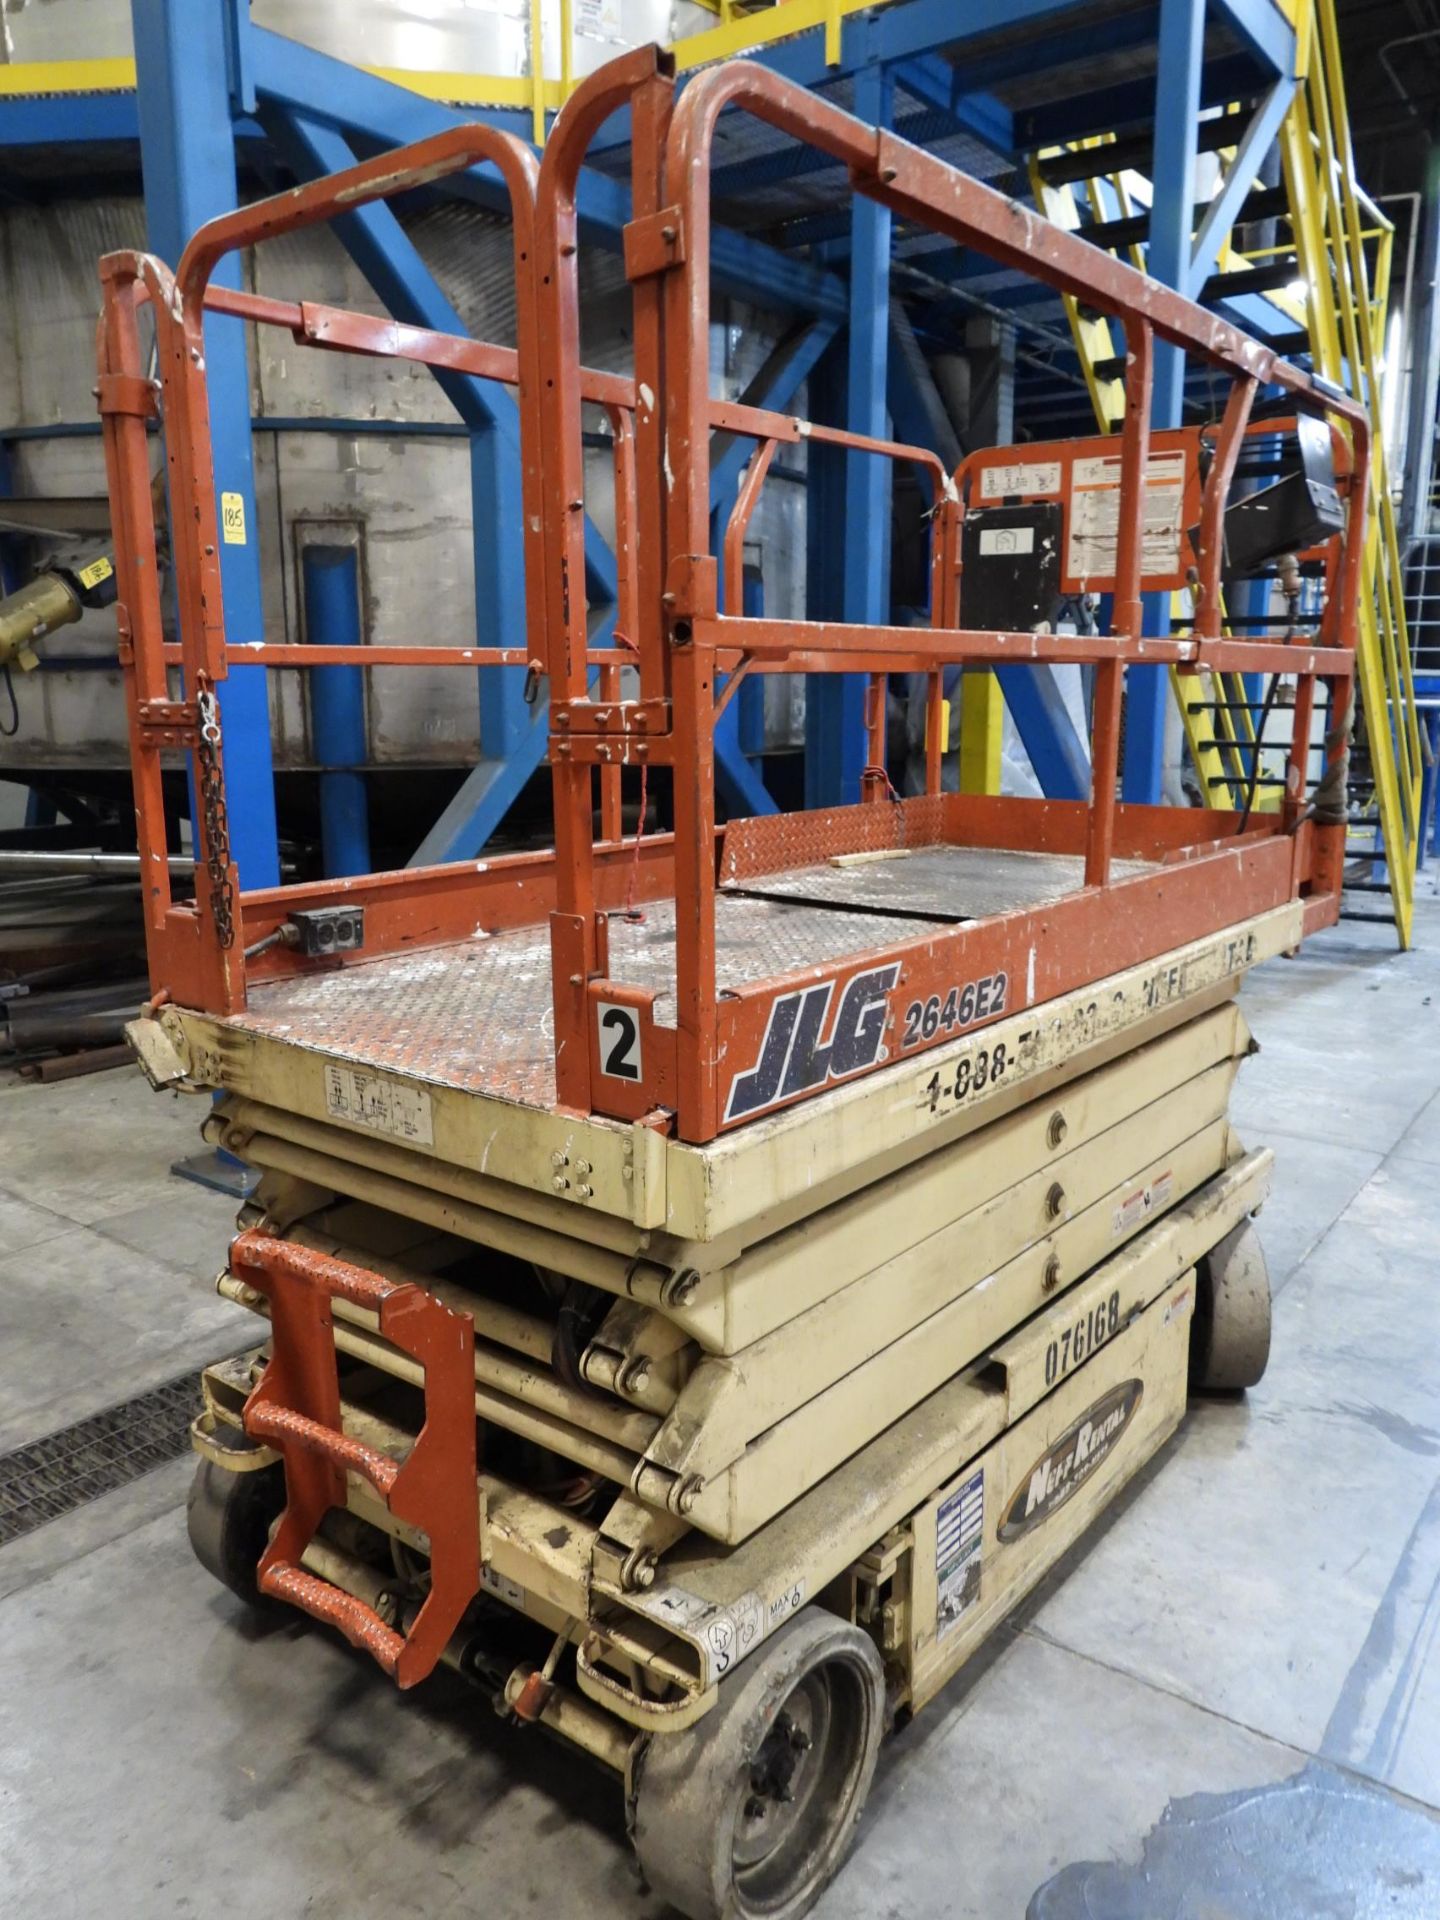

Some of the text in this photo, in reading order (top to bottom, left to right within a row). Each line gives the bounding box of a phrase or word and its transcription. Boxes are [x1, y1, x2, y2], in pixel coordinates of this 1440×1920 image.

[224, 507, 243, 527] 185
[602, 1008, 638, 1080] 2
[725, 962, 902, 1122] JLG
[903, 972, 1009, 1048] 2646E2
[1045, 1290, 1120, 1387] 076168
[1024, 1451, 1074, 1517] NEFF
[1073, 1402, 1126, 1470] RENTAL
[770, 1595, 789, 1616] MAX
